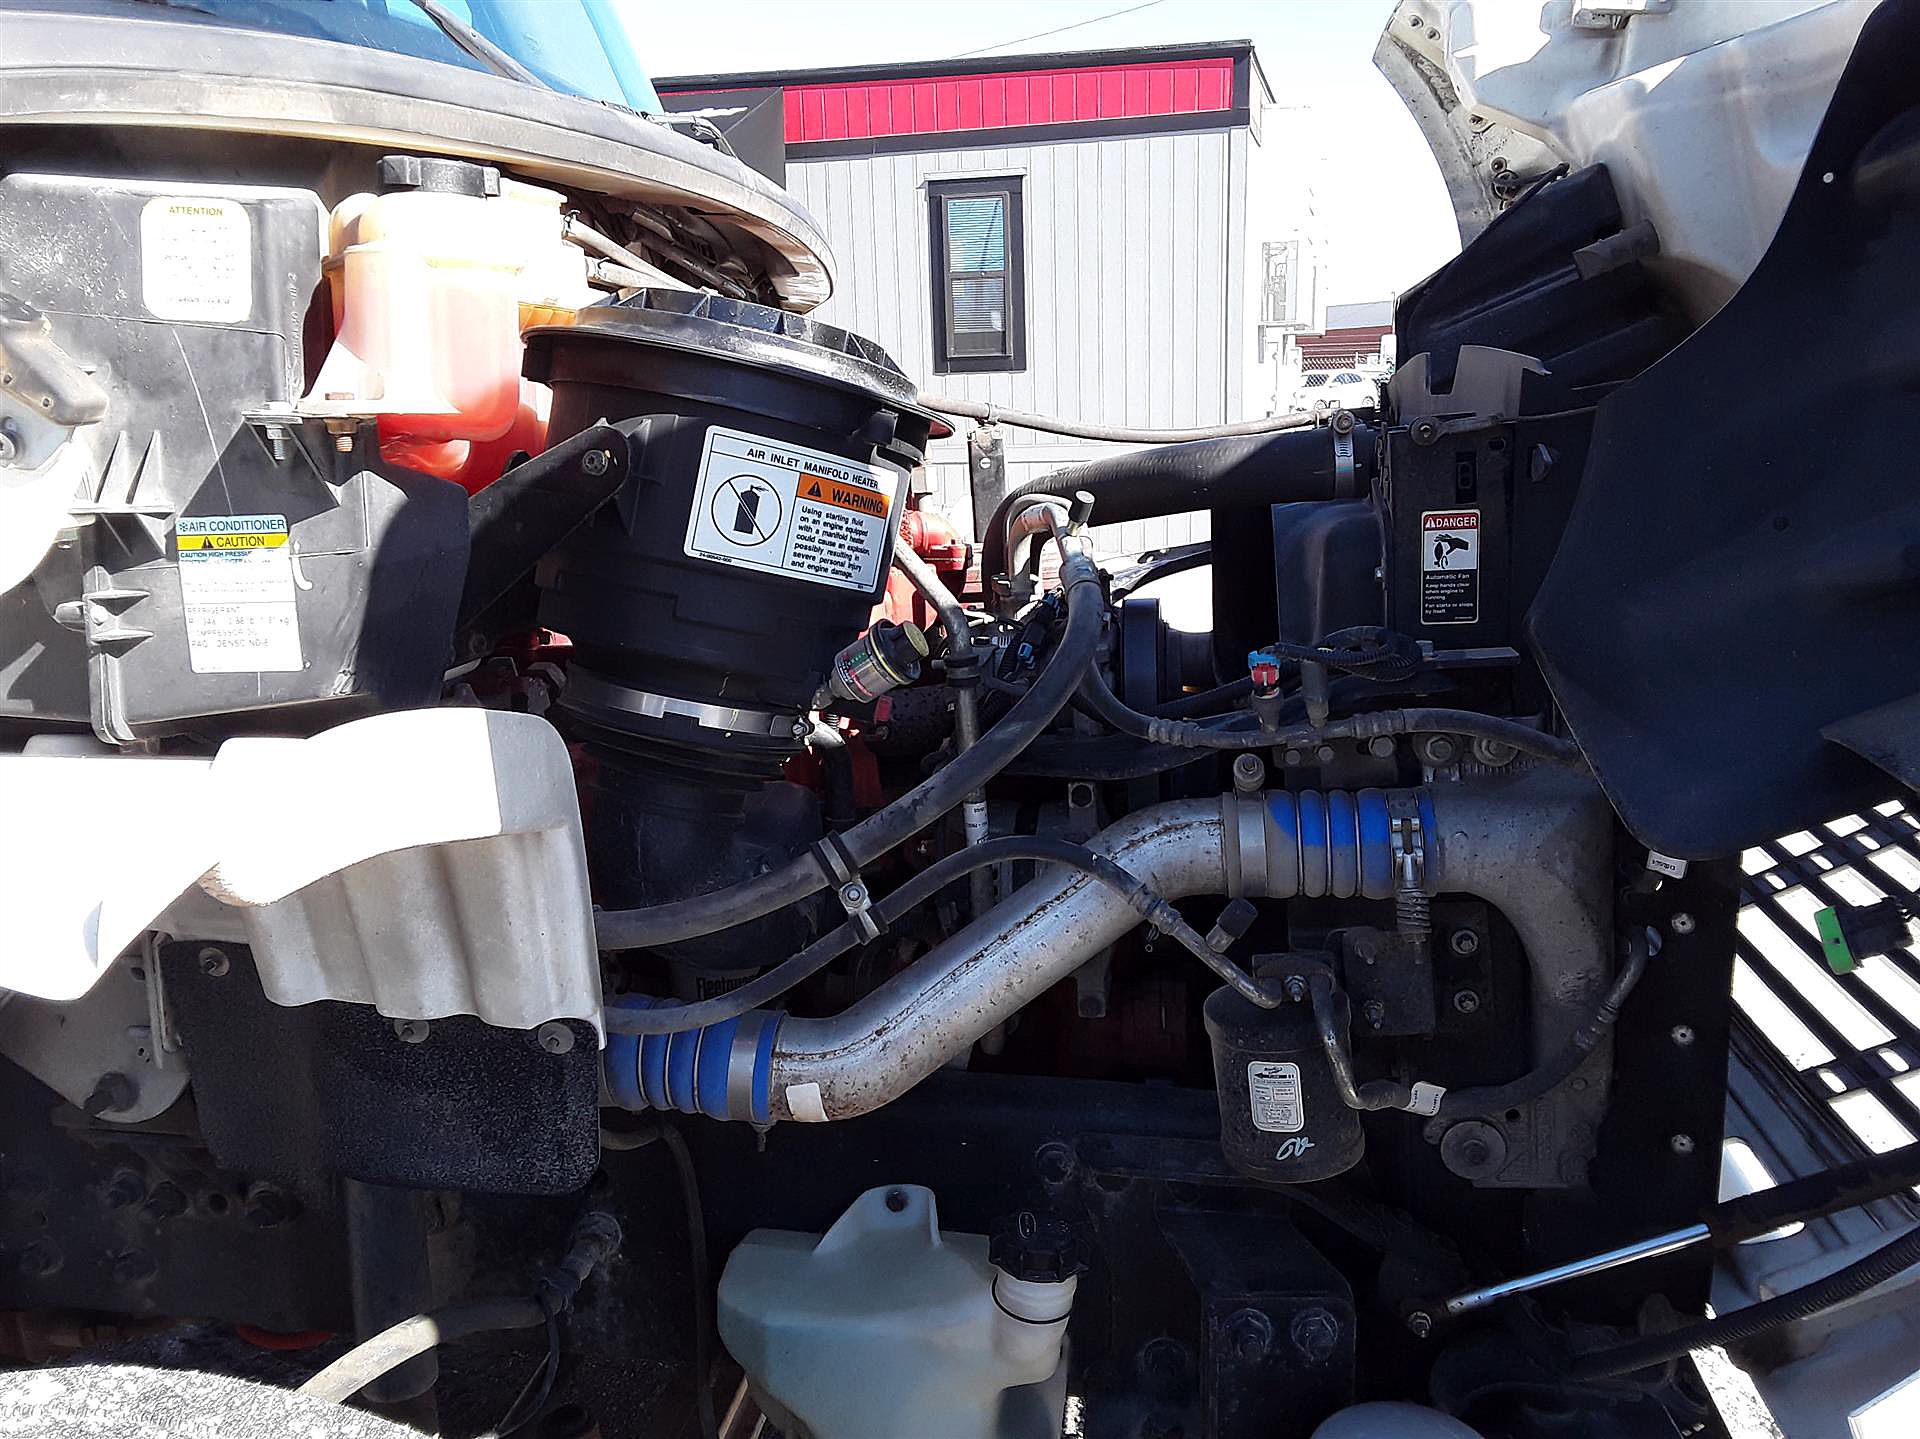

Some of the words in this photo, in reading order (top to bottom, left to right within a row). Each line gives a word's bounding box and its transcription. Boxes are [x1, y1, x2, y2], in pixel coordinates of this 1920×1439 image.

[169, 206, 223, 216] ATTENTION
[747, 448, 766, 460] AIR
[770, 453, 800, 468] INLET
[804, 461, 849, 481] MANIFOLD
[852, 475, 879, 490] HEATER
[832, 488, 883, 513] WARNING
[802, 506, 822, 518] Using
[826, 512, 849, 524] starting
[851, 518, 864, 527] fluid
[1436, 517, 1477, 528] DANGER
[189, 521, 207, 532] AIR
[209, 520, 285, 531] CONDITIONER
[823, 521, 843, 531] engine
[845, 526, 868, 537] equipped
[216, 536, 265, 547] CAUTION
[796, 533, 816, 543] could
[818, 538, 836, 548] cause
[798, 524, 813, 533] with
[822, 530, 848, 541] manifold
[849, 535, 865, 545] heater
[794, 542, 824, 556] possibly
[827, 549, 852, 562] resulting
[791, 559, 805, 568] and
[807, 563, 829, 574] engine
[793, 551, 816, 561] severe
[819, 557, 846, 568] personal
[848, 562, 862, 573] injury
